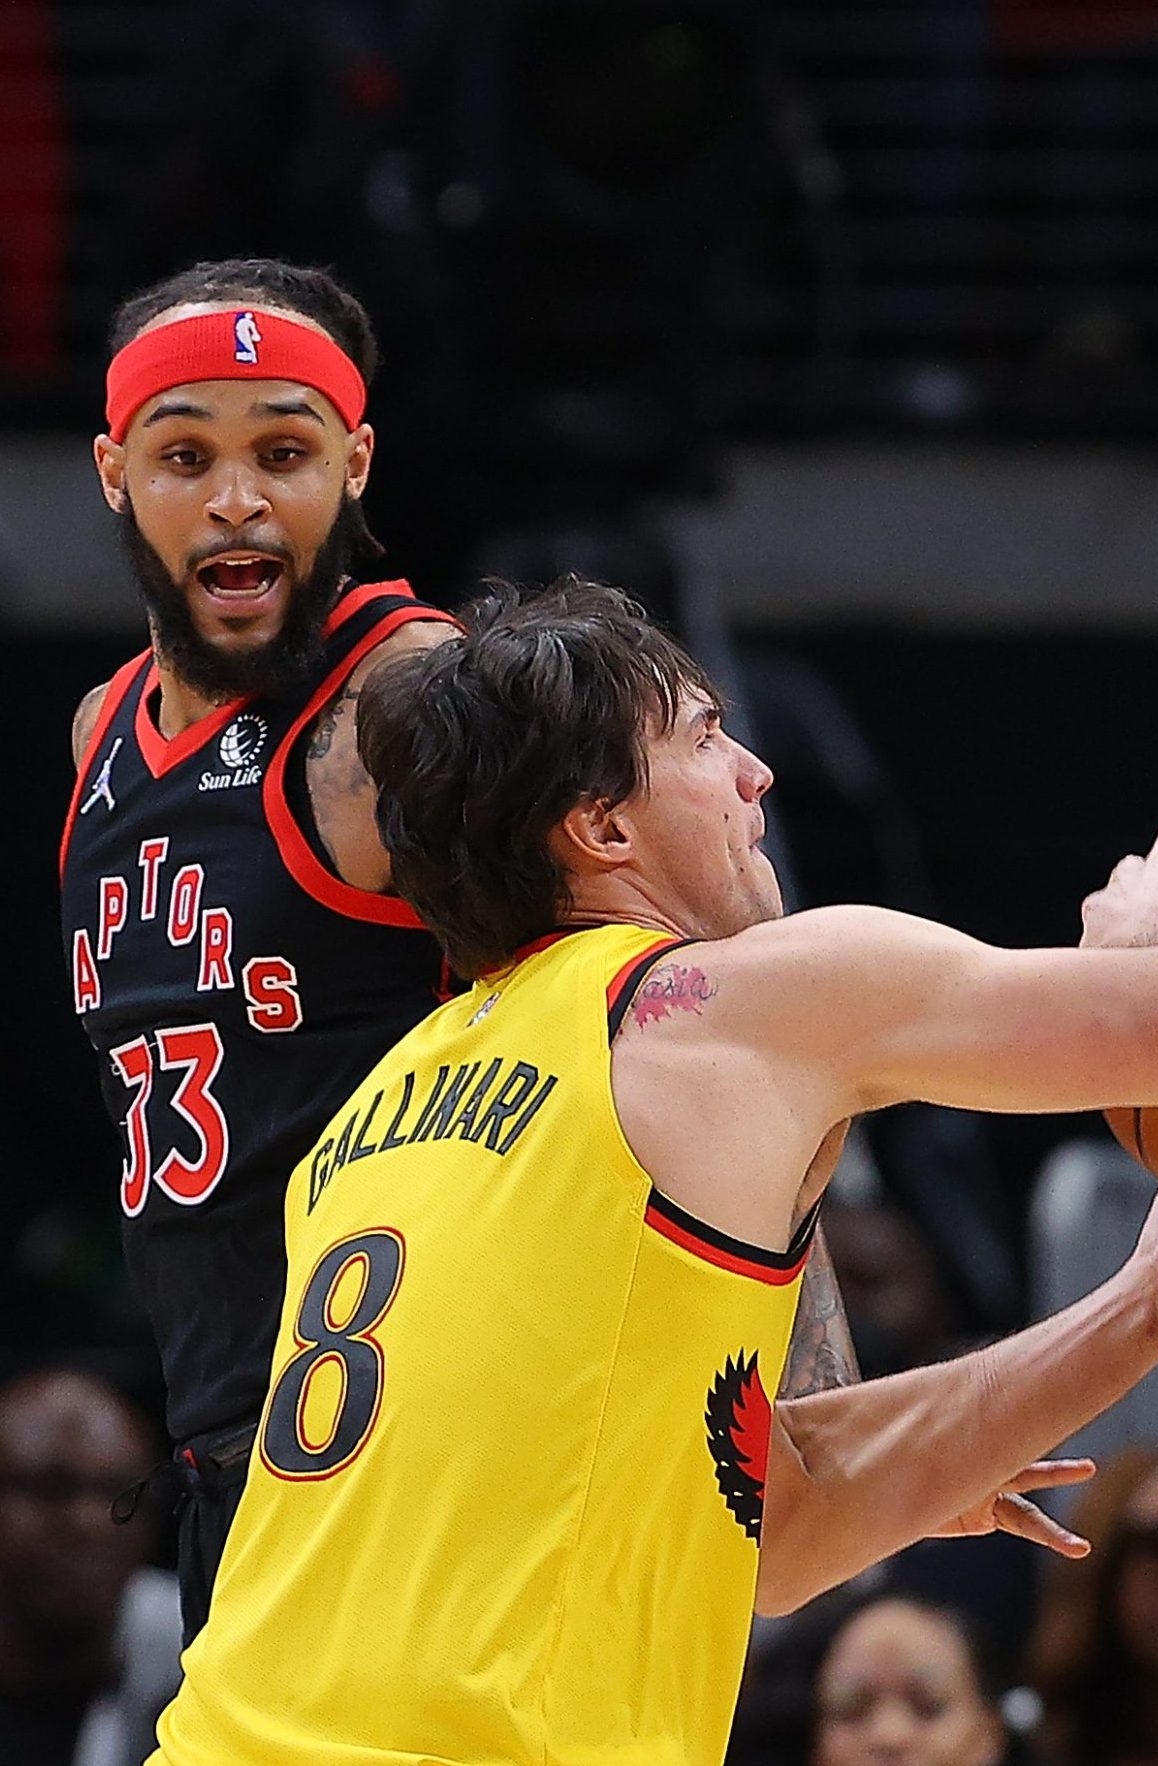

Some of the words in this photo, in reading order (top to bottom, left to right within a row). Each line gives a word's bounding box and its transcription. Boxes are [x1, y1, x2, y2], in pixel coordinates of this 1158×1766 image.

[198, 771, 231, 791] Sun
[72, 836, 304, 1033] APTORS
[306, 1057, 559, 1217] GALLINARI
[259, 1226, 406, 1482] 8
